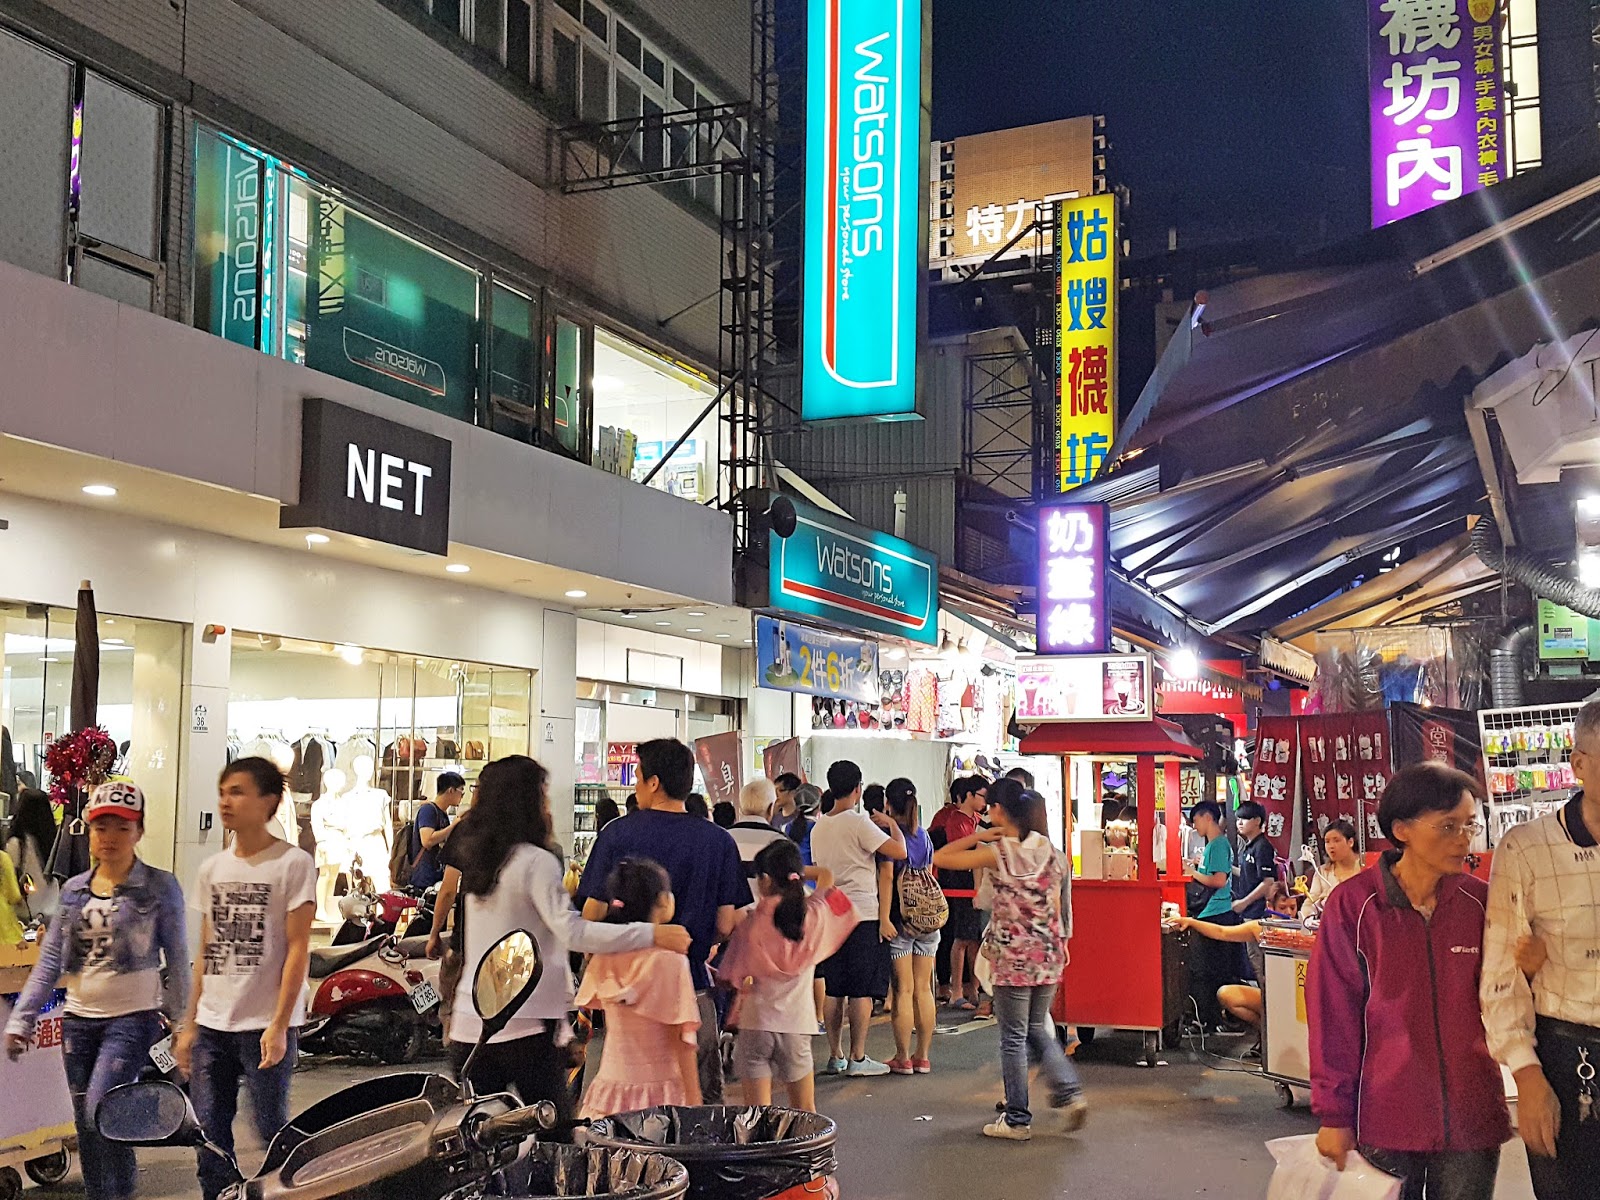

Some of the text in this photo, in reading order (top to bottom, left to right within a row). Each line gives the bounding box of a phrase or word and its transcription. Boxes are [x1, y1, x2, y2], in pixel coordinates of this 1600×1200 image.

[852, 31, 890, 257] Watsons
[839, 166, 854, 301] your personal store
[346, 443, 432, 516] NET
[816, 536, 893, 593] Watsons
[799, 645, 855, 693] 2件6折
